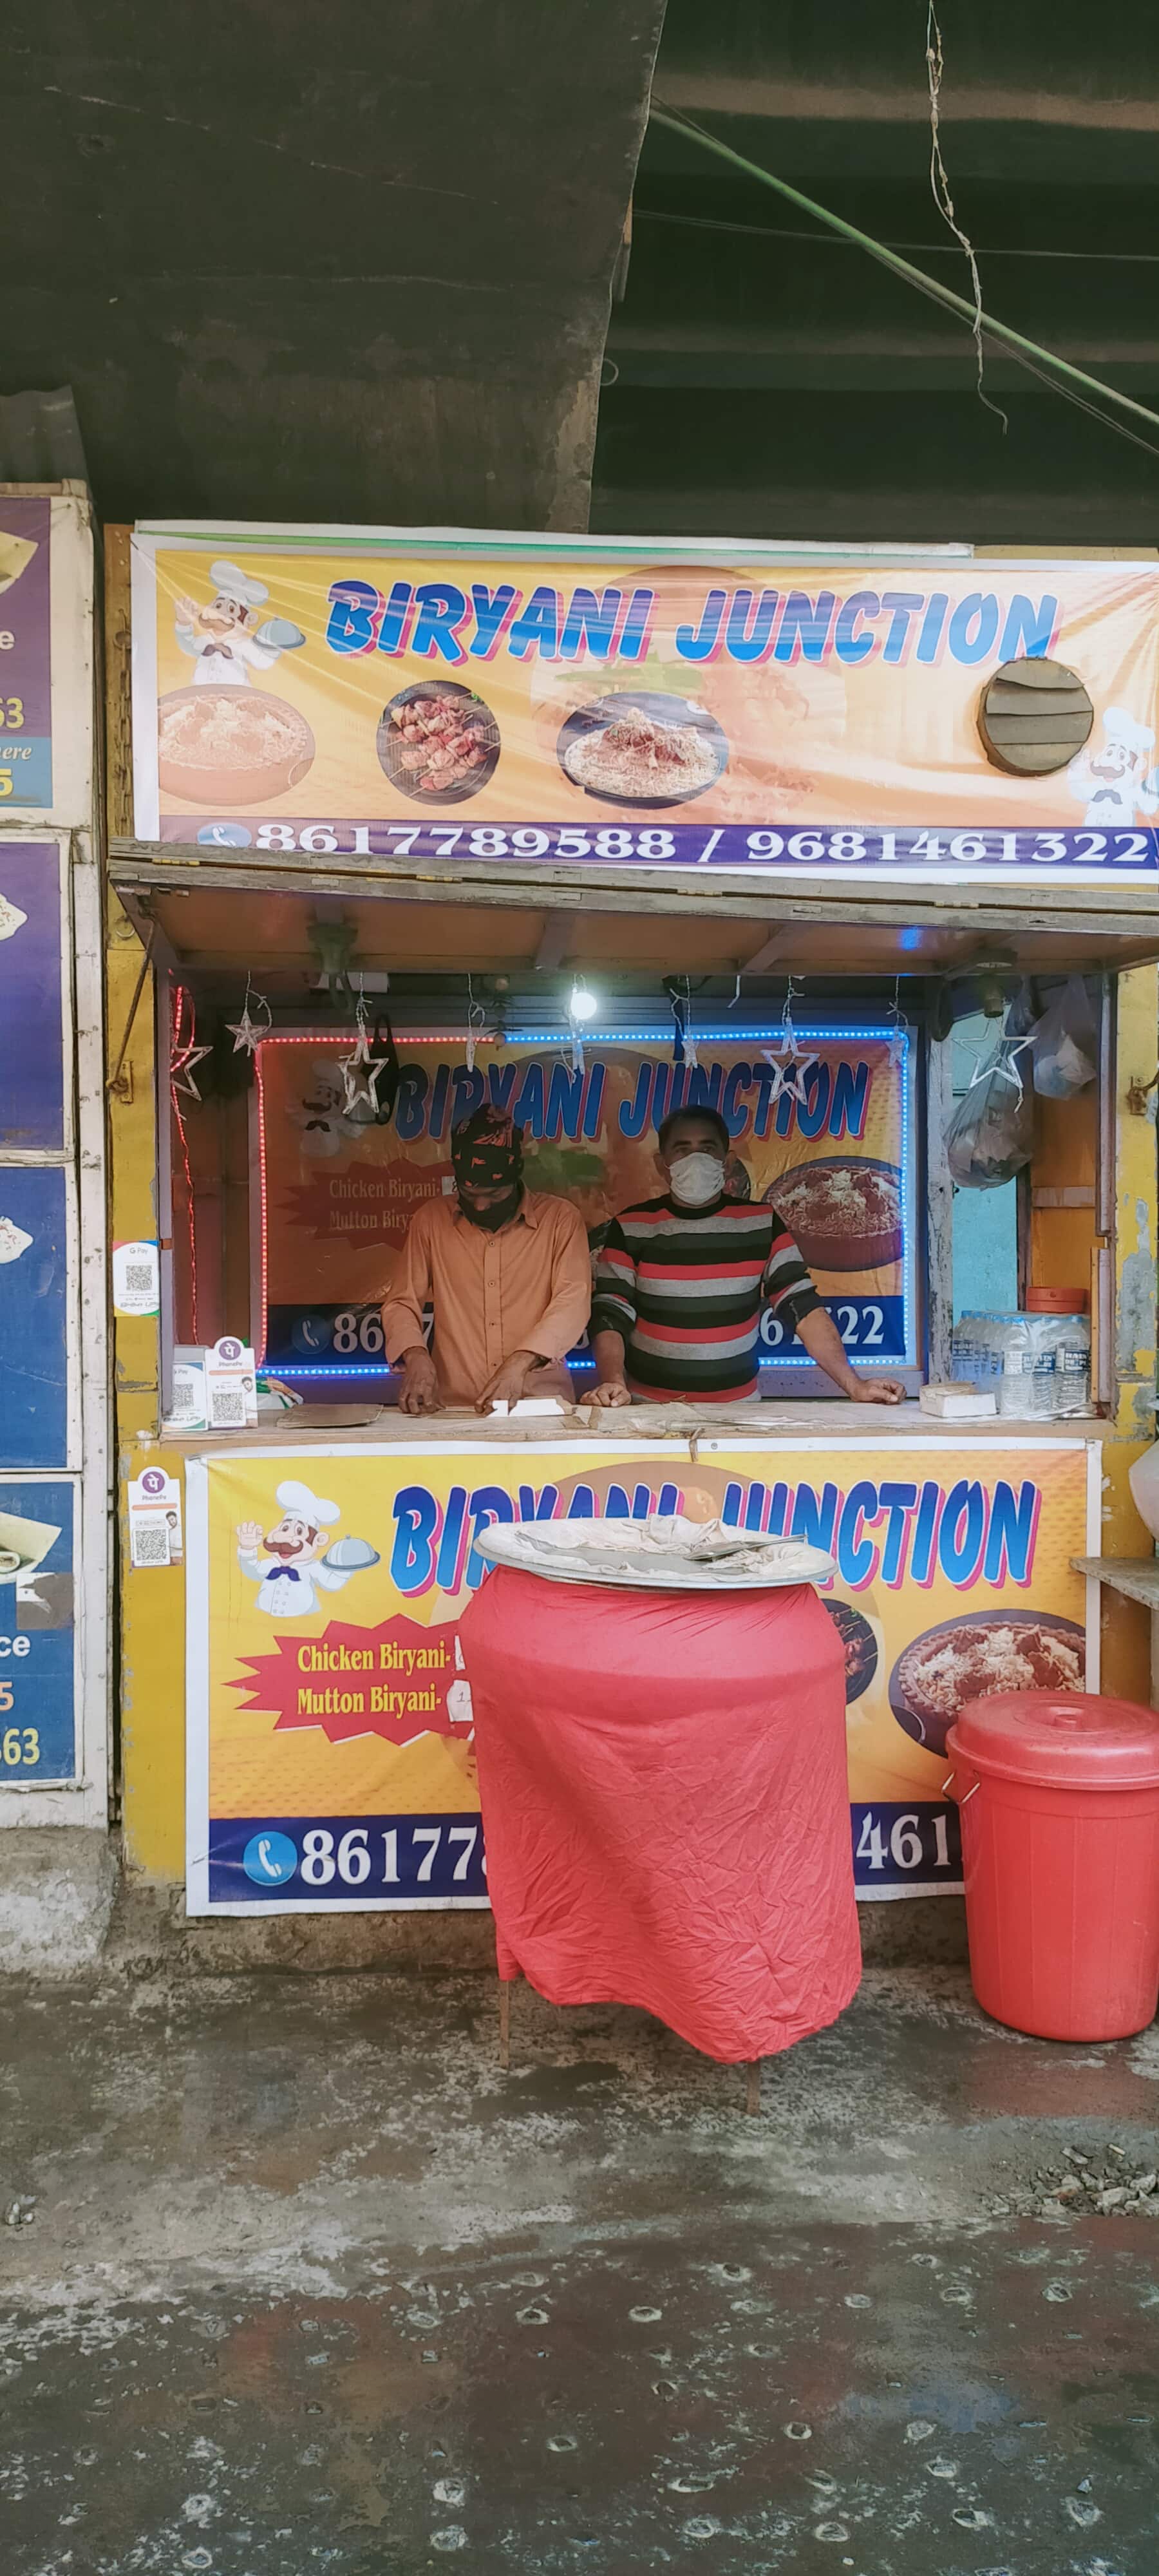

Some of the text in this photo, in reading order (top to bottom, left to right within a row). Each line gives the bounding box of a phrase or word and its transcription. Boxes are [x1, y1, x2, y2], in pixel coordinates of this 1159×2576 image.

[325, 580, 1061, 666] BIRYANI JUNCTION
[0, 746, 32, 761] ere
[256, 824, 676, 859] 8617789588
[747, 830, 1149, 862] 9681461322
[329, 1179, 384, 1198] Chicken
[329, 1208, 413, 1234] Mutton Biry
[297, 1642, 373, 1672] Chicken
[297, 1687, 365, 1715] Mutton
[0, 1727, 40, 1765] 63
[299, 1825, 486, 1886] 86177
